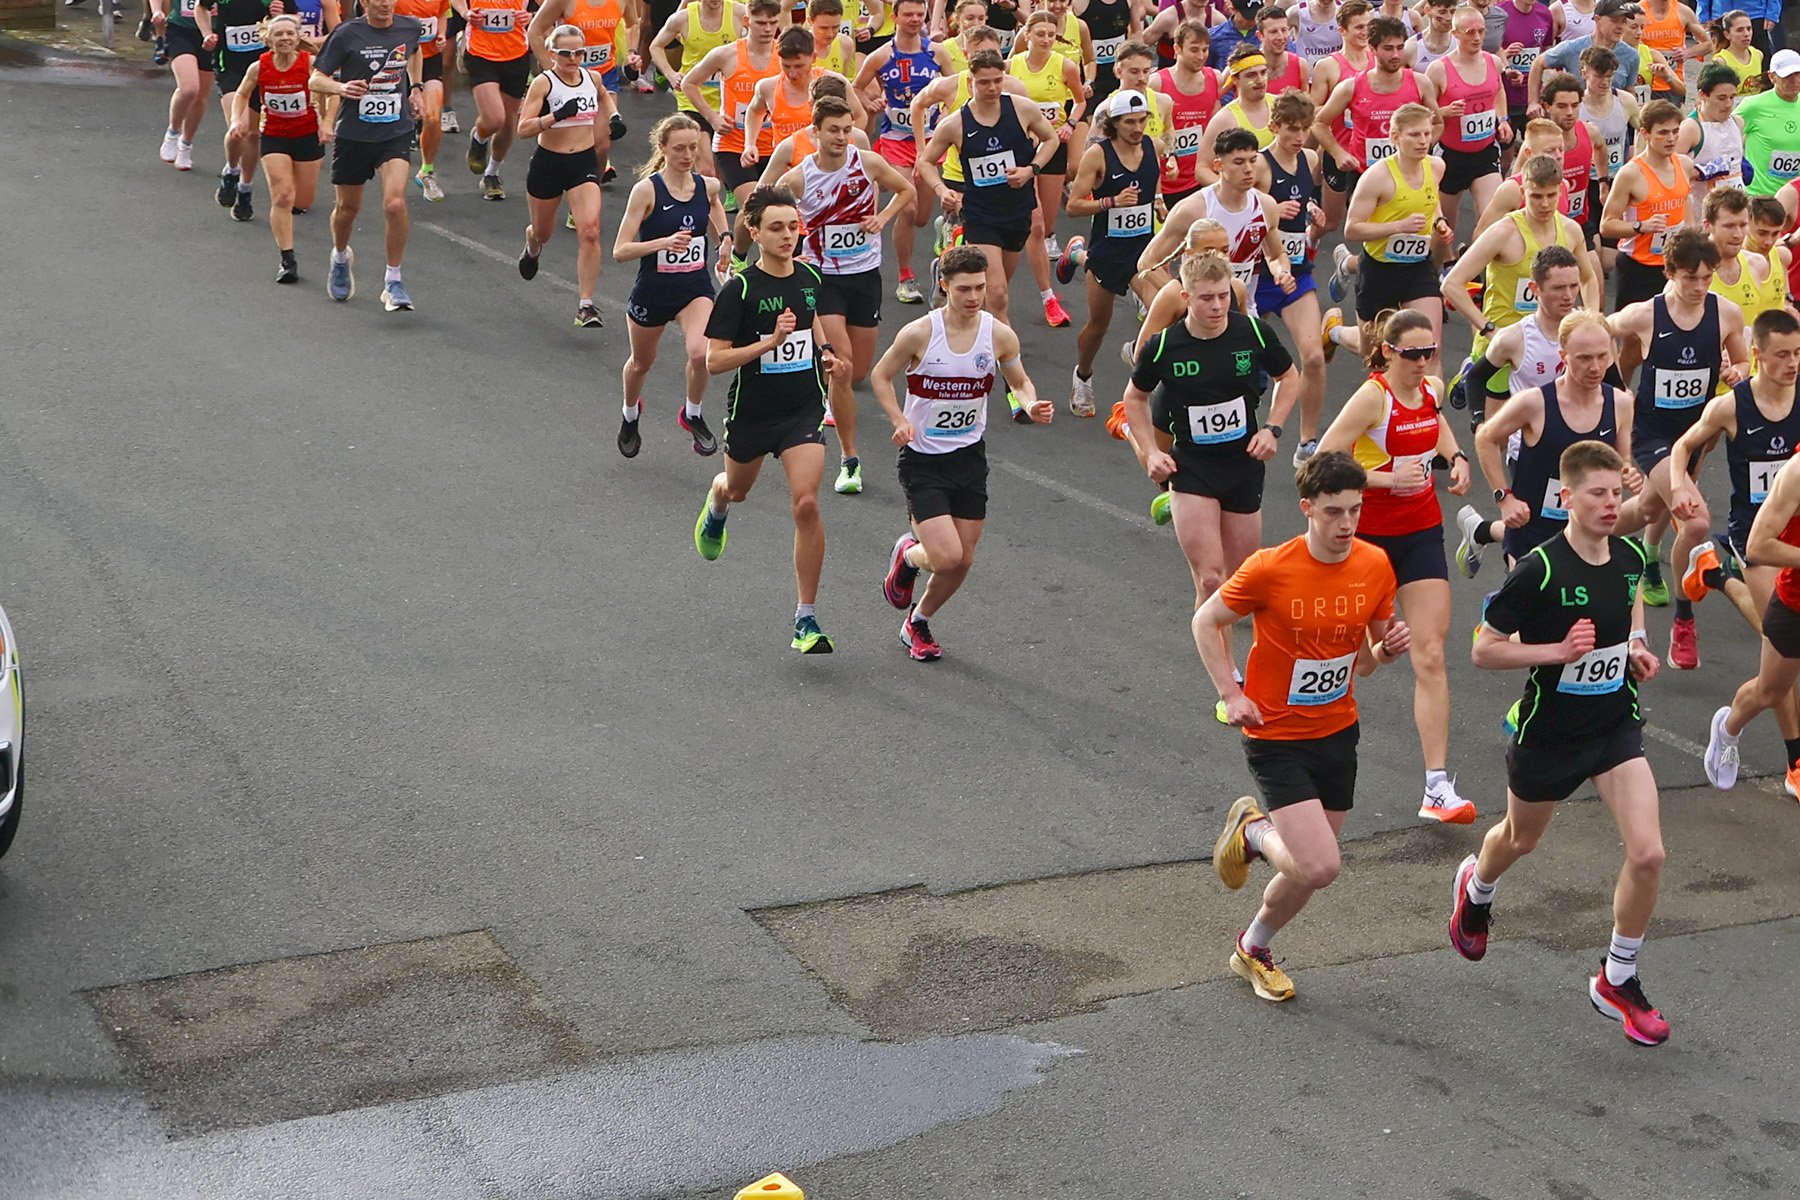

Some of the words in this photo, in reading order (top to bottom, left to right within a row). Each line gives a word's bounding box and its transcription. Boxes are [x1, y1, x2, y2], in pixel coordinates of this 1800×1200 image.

[420, 23, 433, 35] 51
[483, 14, 509, 27] 141
[231, 30, 260, 44] 195
[583, 48, 608, 63] 155
[1512, 53, 1536, 66] 029
[269, 98, 301, 112] 614
[364, 100, 396, 115] 291
[578, 97, 596, 111] 34
[1466, 117, 1493, 135] 014
[976, 159, 1007, 178] 191
[1773, 157, 1800, 172] 062
[1648, 198, 1685, 213] ALEHOU
[1114, 212, 1147, 229] 186
[831, 230, 866, 249] 203
[1392, 238, 1426, 255] 078
[665, 245, 700, 264] 626
[758, 296, 783, 313] AW
[772, 339, 806, 362] 197
[1173, 360, 1200, 377] DD
[922, 377, 971, 391] Western
[1662, 378, 1702, 398] 188
[935, 408, 977, 429] 236
[1197, 409, 1241, 434] 194
[1561, 586, 1589, 606] LS
[1291, 594, 1366, 619] DROP
[1574, 656, 1620, 682] 196
[1297, 665, 1349, 694] 289
